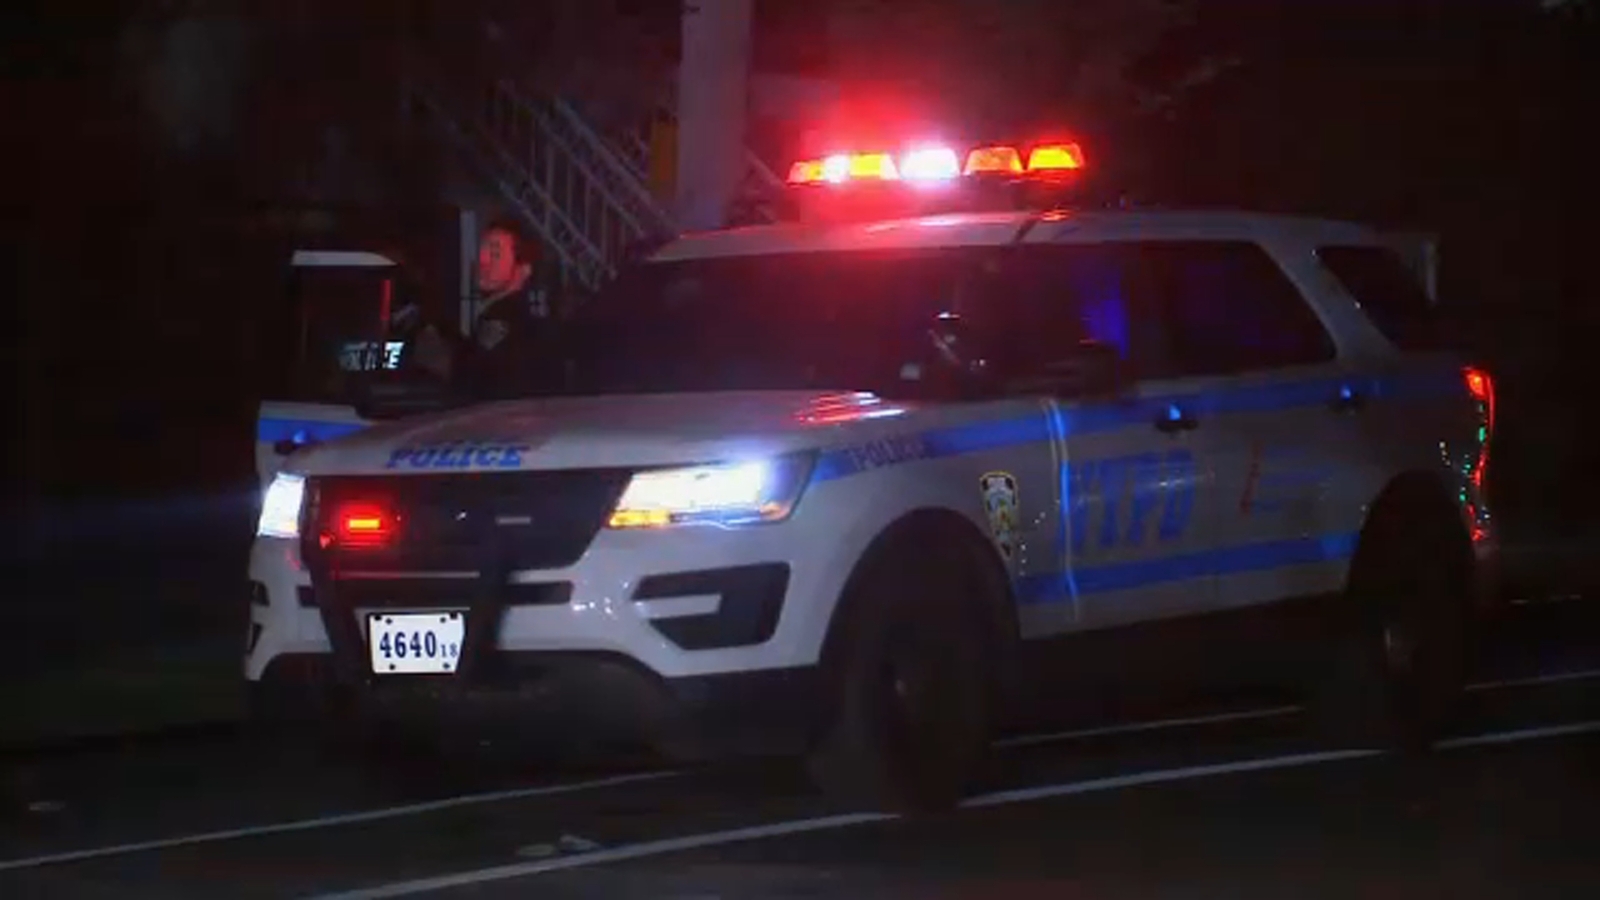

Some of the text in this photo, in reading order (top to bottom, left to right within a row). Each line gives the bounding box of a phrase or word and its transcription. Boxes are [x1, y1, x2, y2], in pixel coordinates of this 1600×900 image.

[339, 341, 405, 371] OLIE
[386, 444, 530, 468] POLICE
[1057, 450, 1195, 552] NYPD
[379, 631, 458, 658] 4640 18
